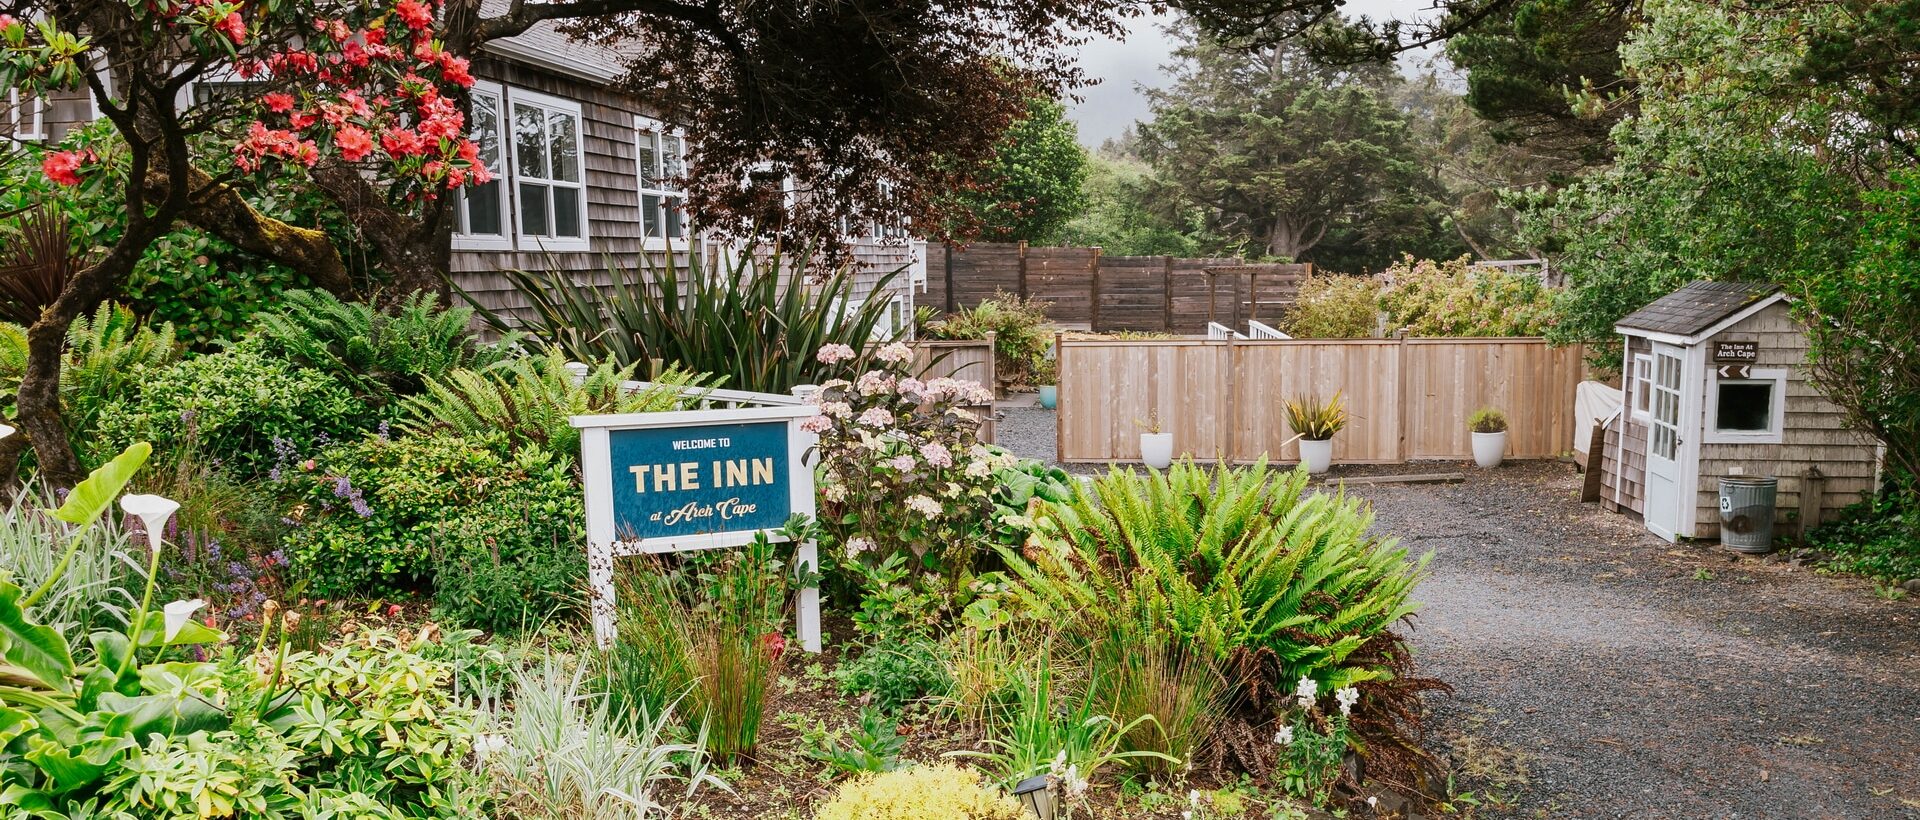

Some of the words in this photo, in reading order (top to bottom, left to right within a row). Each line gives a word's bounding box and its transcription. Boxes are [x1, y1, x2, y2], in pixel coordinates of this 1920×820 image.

[1737, 350, 1755, 358] Cape
[672, 439, 716, 450] WELCOME
[718, 437, 730, 448] TO
[629, 462, 700, 493] THE
[712, 457, 774, 488] INN
[650, 510, 663, 522] at
[664, 501, 713, 526] Arch
[716, 497, 757, 520] Cape
